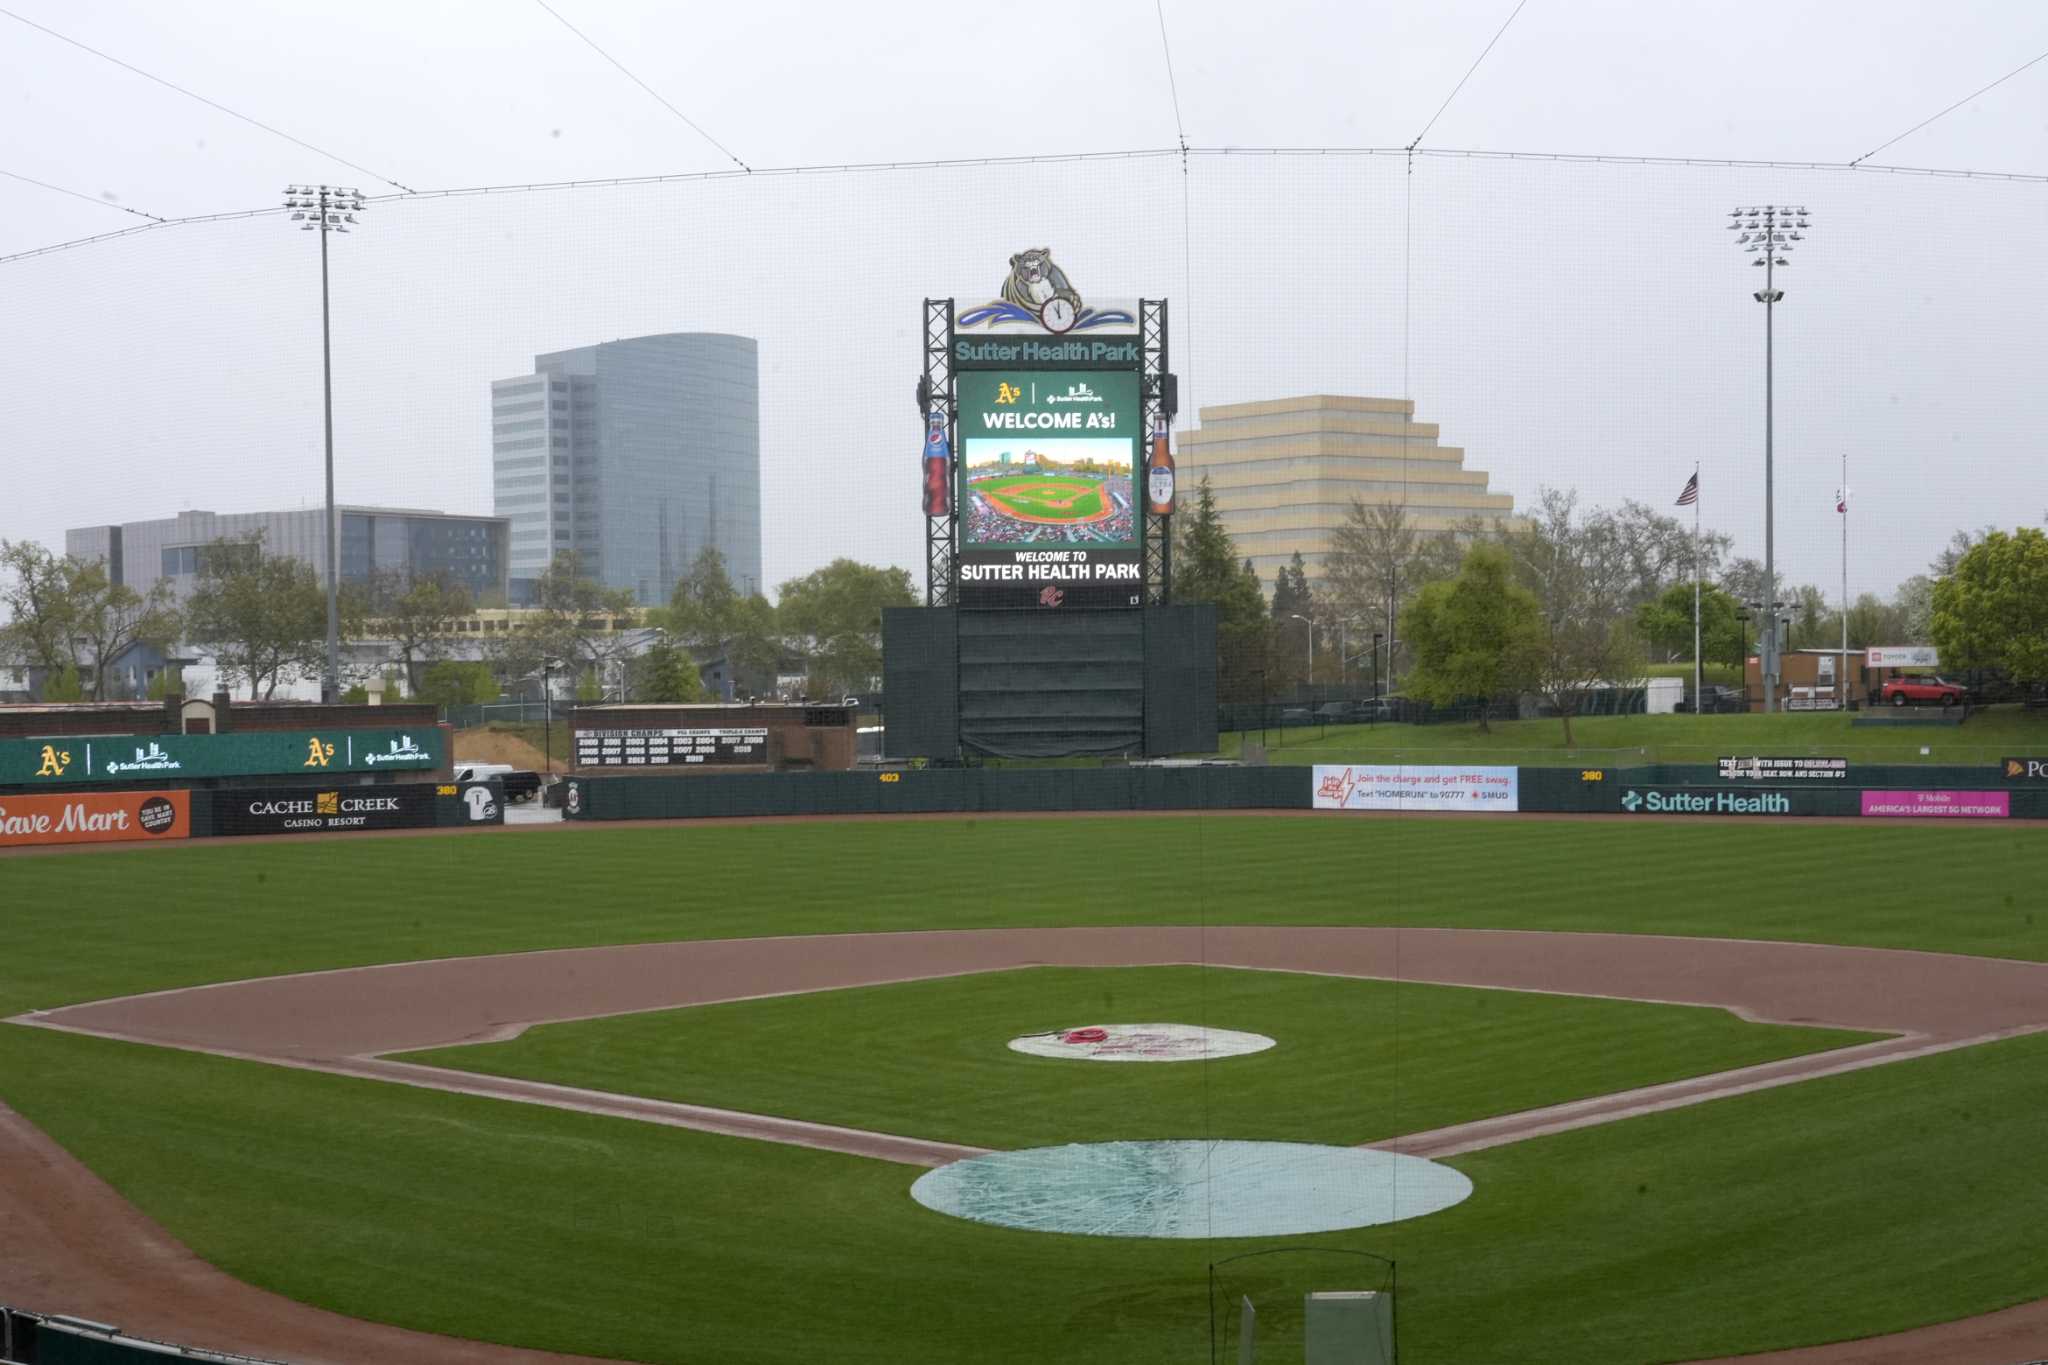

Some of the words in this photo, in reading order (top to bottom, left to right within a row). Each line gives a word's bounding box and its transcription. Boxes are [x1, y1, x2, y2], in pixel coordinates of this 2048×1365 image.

[955, 341, 1021, 361] Sutter
[1023, 341, 1090, 361] Health
[1092, 341, 1140, 361] Park
[995, 382, 1021, 405] A's
[982, 412, 1082, 429] WELCOME
[1086, 412, 1116, 429] A's!
[1015, 551, 1070, 562] WELCOME
[1072, 551, 1087, 562] TO
[960, 564, 1024, 580] SUTTER
[1028, 564, 1090, 580] HEALTH
[1095, 563, 1141, 579] PARK
[593, 729, 629, 738] DIVISION
[631, 729, 664, 737] CHAMPS
[304, 736, 335, 767] A's
[376, 753, 396, 762] Sutter
[395, 753, 415, 761] Health
[34, 744, 72, 777] A's
[119, 762, 141, 771] Sutter
[141, 761, 164, 769] Health
[1794, 760, 1803, 768] TO
[879, 772, 900, 783] 403
[1719, 769, 1745, 777] INCDE
[1357, 774, 1374, 783] Join
[1376, 774, 1391, 783] the
[1392, 774, 1421, 785] charge
[1424, 774, 1440, 783] and
[1442, 775, 1458, 785] get
[1460, 774, 1484, 783] FREE
[1482, 791, 1509, 799] SMUD
[249, 800, 314, 815] CACHE
[340, 797, 400, 812] CREEK
[1646, 791, 1714, 812] Sutter
[1717, 792, 1790, 813] Health
[1869, 805, 1912, 814] AMERICA'S
[1913, 805, 1948, 814] LARGEST
[1960, 805, 2001, 815] NETWORK
[55, 803, 130, 833] Mart
[144, 816, 172, 828] COUNTRY
[284, 818, 322, 828] CASINO
[328, 816, 366, 827] RESORT
